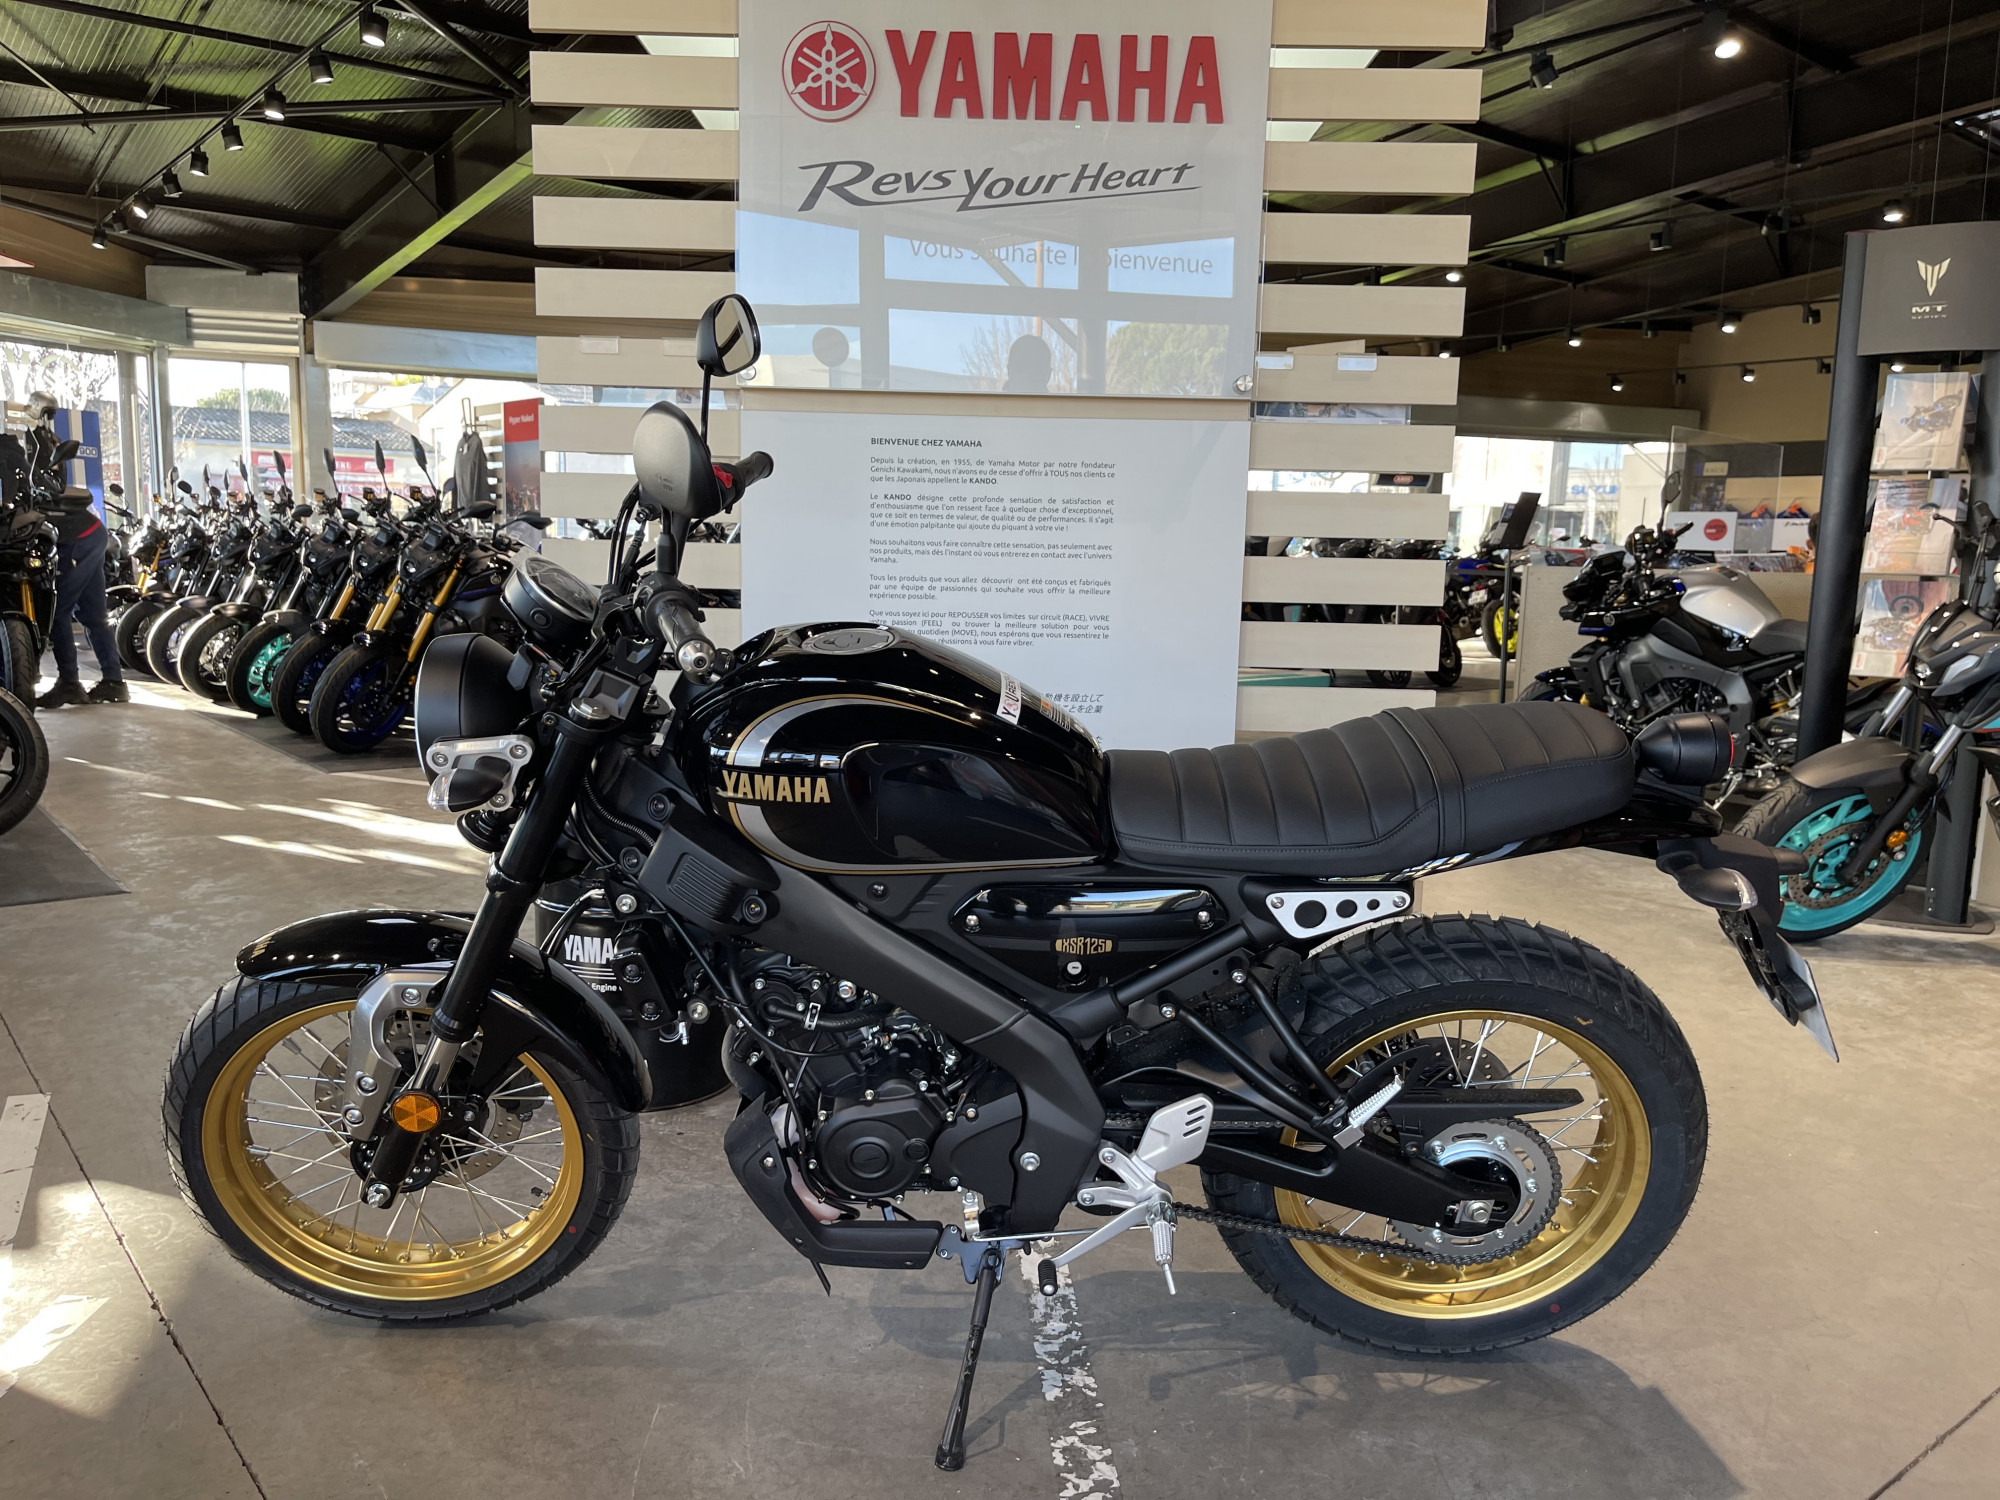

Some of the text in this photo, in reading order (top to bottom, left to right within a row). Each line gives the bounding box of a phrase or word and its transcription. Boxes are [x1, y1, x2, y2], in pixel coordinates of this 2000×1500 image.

[885, 30, 1224, 123] YAMAHA
[798, 161, 1197, 211] Revs Your Heart
[1911, 304, 1949, 313] MT
[870, 437, 982, 447] BIENVENUE CHEZ YAMAHA
[870, 456, 894, 464] Depuis
[1080, 460, 1116, 469] fondateur
[896, 475, 926, 484] Japonais
[927, 475, 959, 484] appellent
[883, 493, 912, 501] KANDO
[916, 493, 944, 502] désigne
[972, 495, 1004, 504] profonde
[1061, 497, 1101, 505] satisfaction
[1008, 505, 1036, 514] quelque
[1039, 505, 1059, 513] chose
[990, 513, 1014, 522] qualité
[920, 520, 954, 530] palpitante
[968, 522, 990, 531] ajoute
[1002, 523, 1027, 532] piquant
[888, 538, 925, 546] souhaitons
[942, 539, 958, 547] faire
[959, 540, 992, 548] connaître
[898, 574, 927, 583] produits
[1078, 578, 1111, 587] fabriqués
[900, 583, 924, 591] équipe
[940, 584, 977, 593] passionnés
[1047, 586, 1065, 594] offrir
[869, 591, 906, 600] expérience
[722, 770, 831, 803] YAMAHA
[1063, 937, 1106, 955] XSR125
[591, 983, 618, 992] Engine
